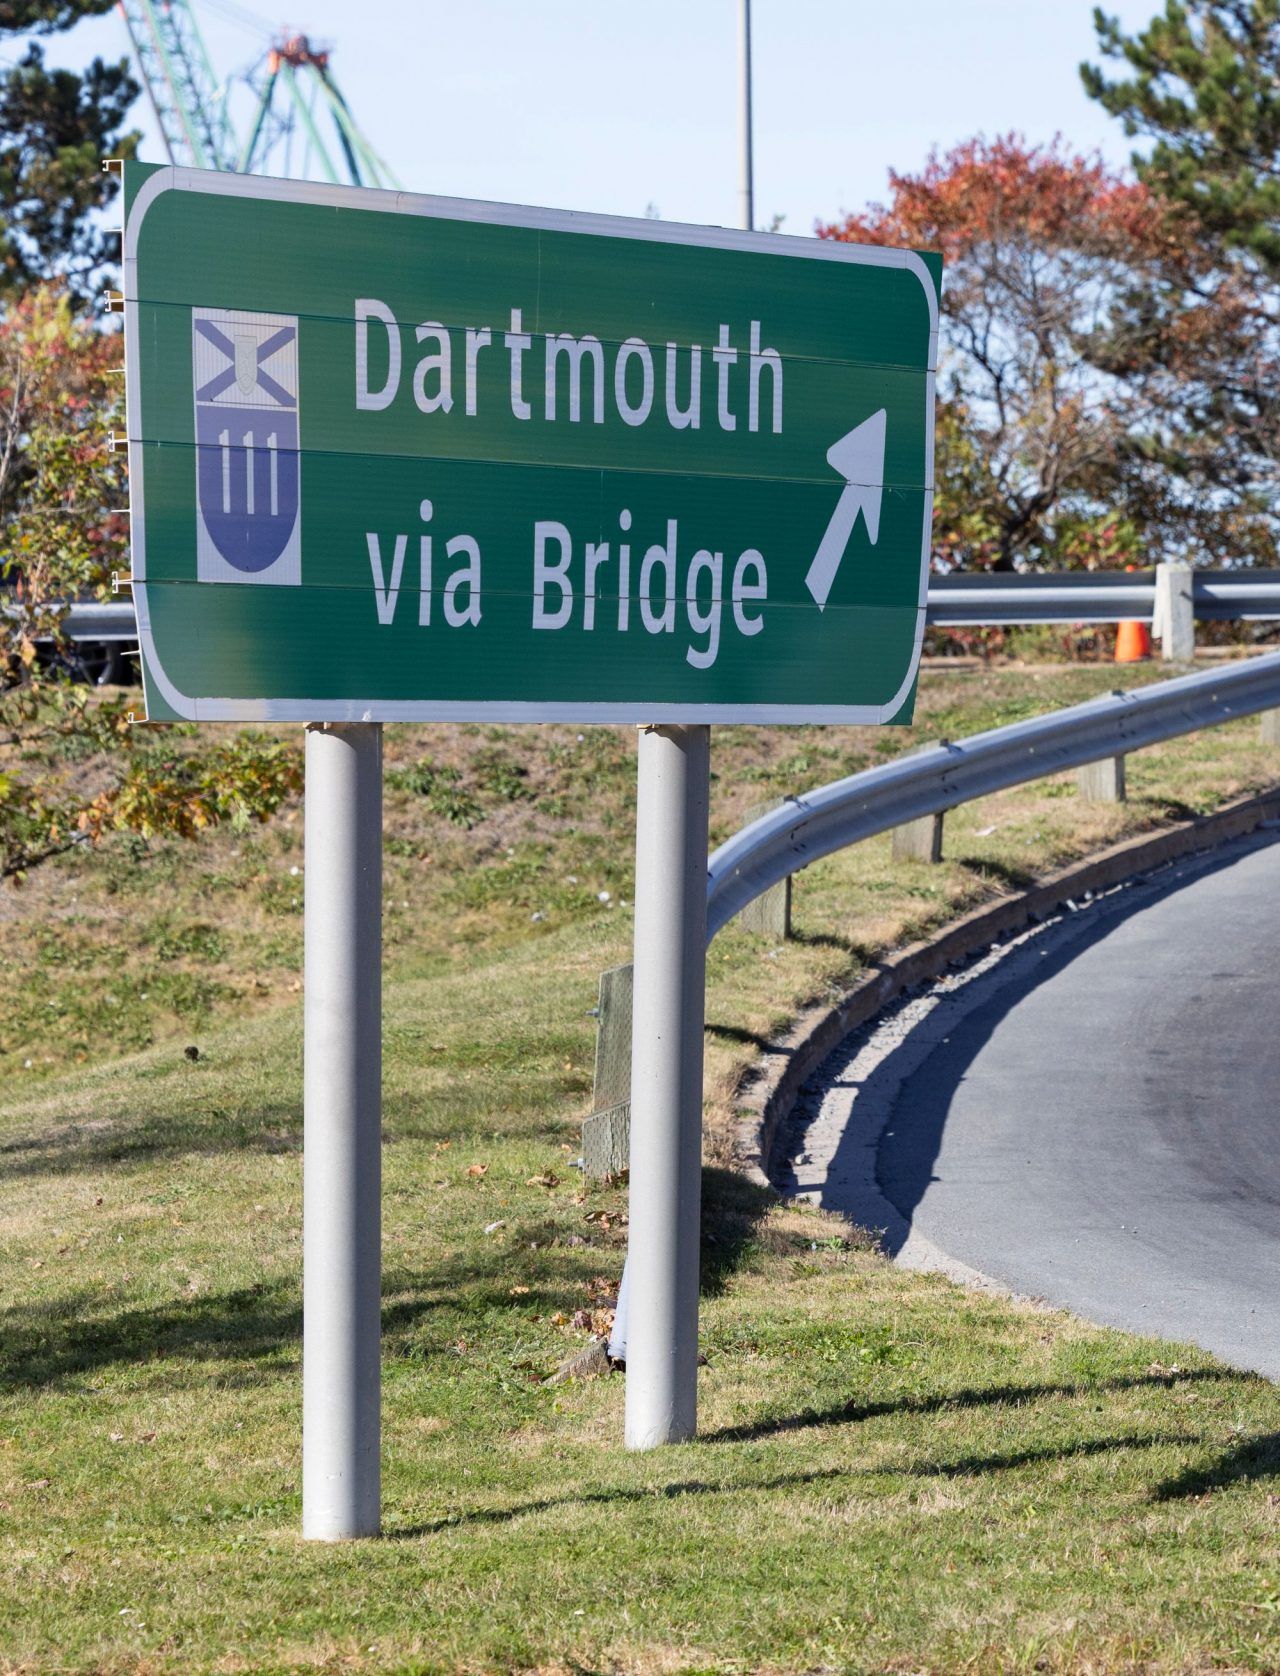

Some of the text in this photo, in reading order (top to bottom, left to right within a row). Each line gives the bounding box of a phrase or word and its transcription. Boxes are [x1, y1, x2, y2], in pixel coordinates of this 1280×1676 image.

[354, 298, 784, 434] Dartmouth
[218, 428, 278, 516] 111
[366, 499, 769, 670] via Bridge
